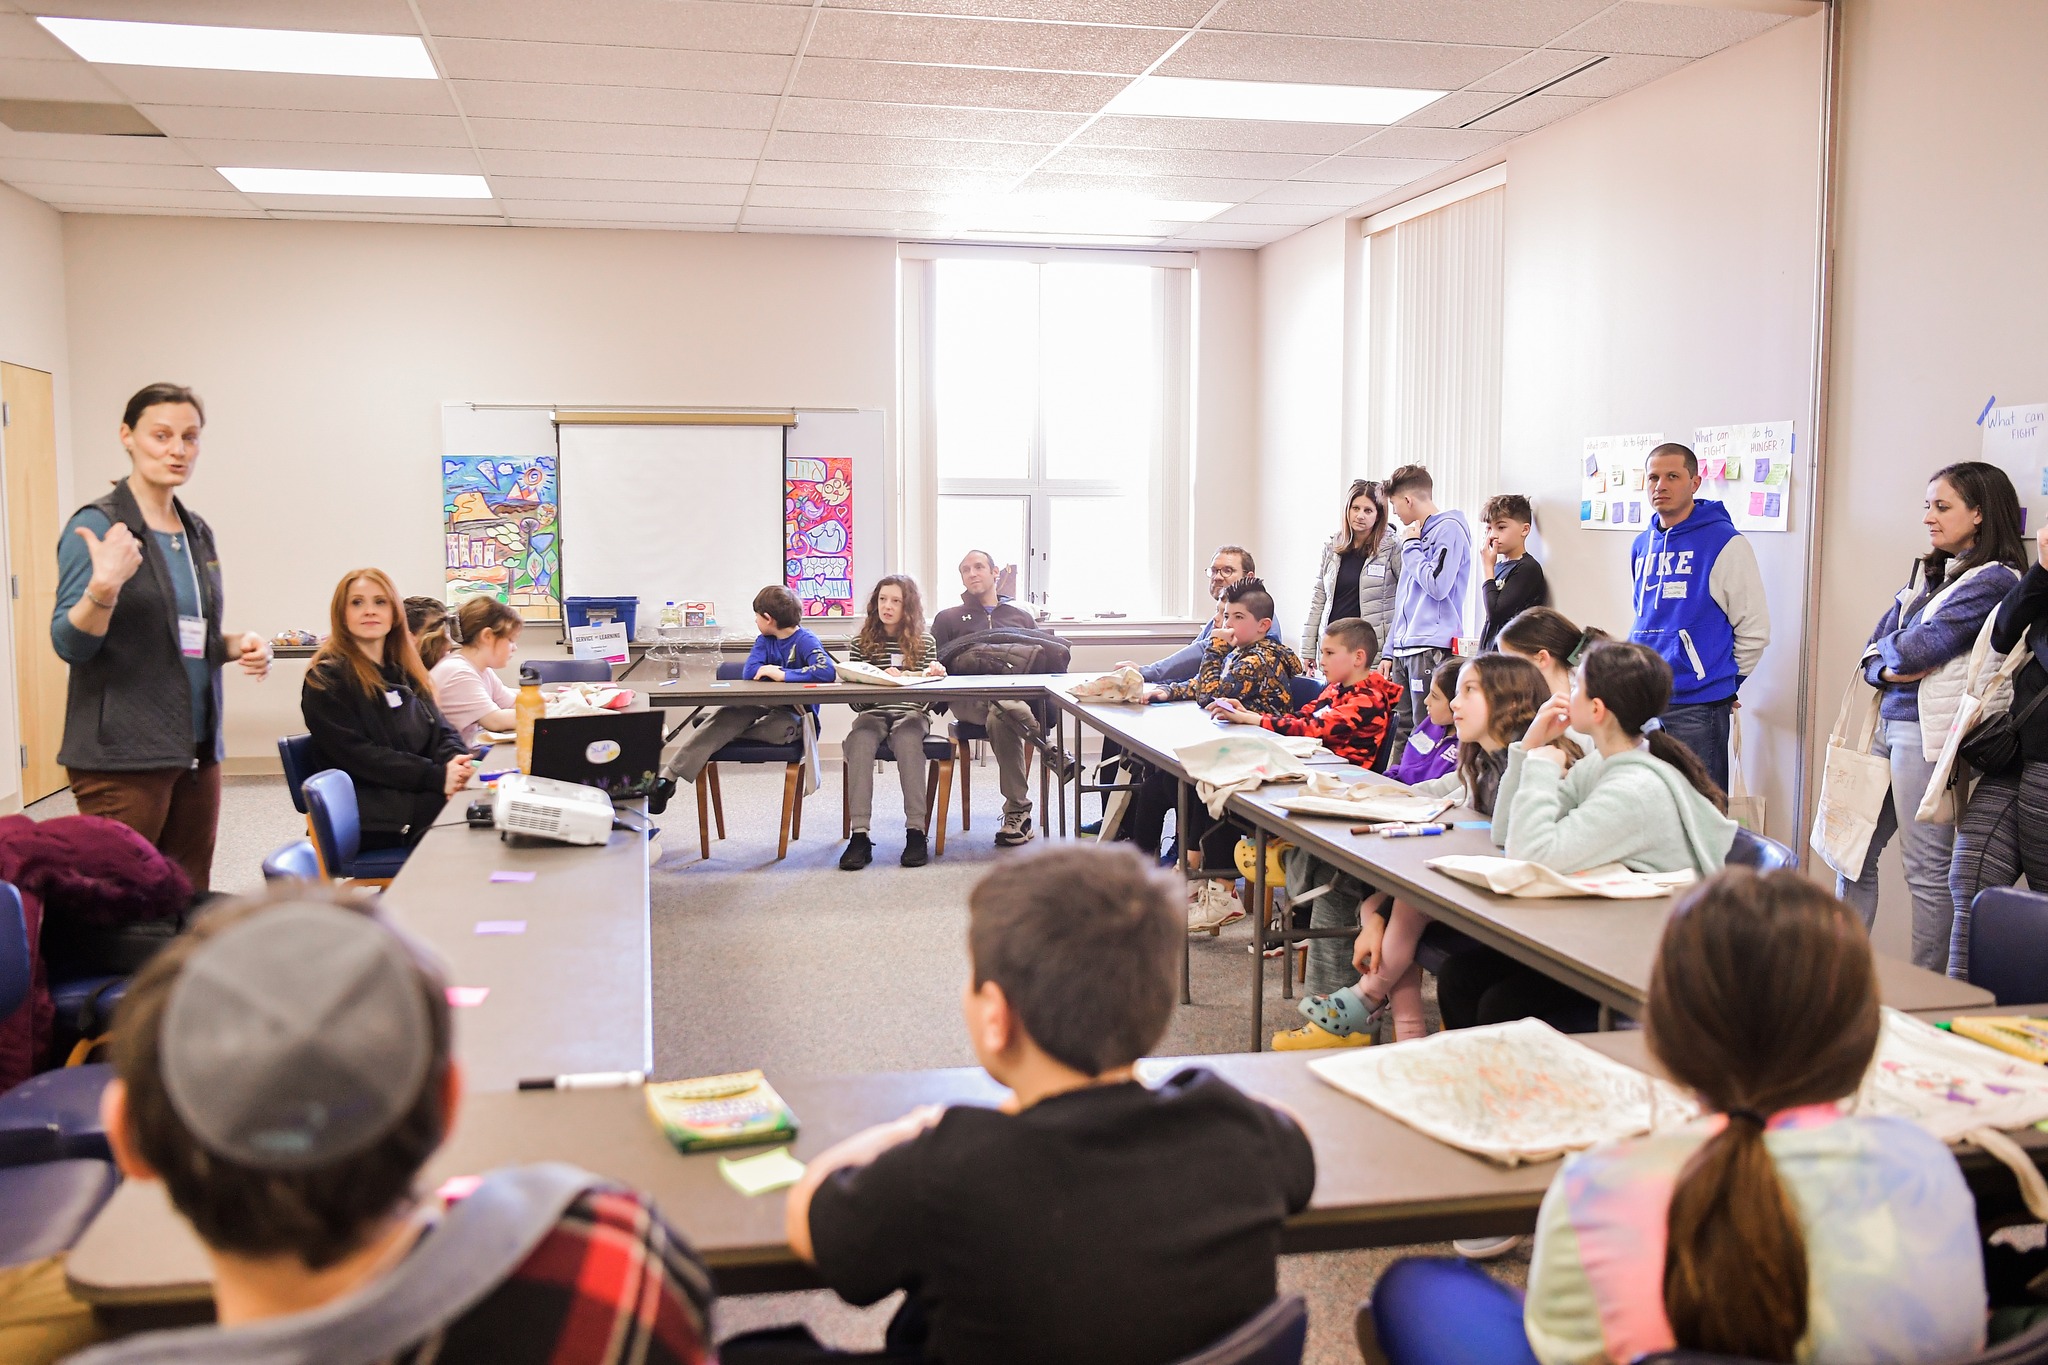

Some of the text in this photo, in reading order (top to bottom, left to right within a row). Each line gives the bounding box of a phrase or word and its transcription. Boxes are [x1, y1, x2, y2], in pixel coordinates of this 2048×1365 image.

[1987, 410, 2045, 429] What can
[1695, 430, 1713, 443] What
[1717, 431, 1729, 442] can
[1752, 427, 1761, 438] do
[1764, 426, 1773, 438] to
[2011, 426, 2038, 439] FIGHT
[1703, 444, 1727, 456] FIGHT
[1750, 440, 1778, 453] HUNGER
[575, 635, 594, 643] SERVICE
